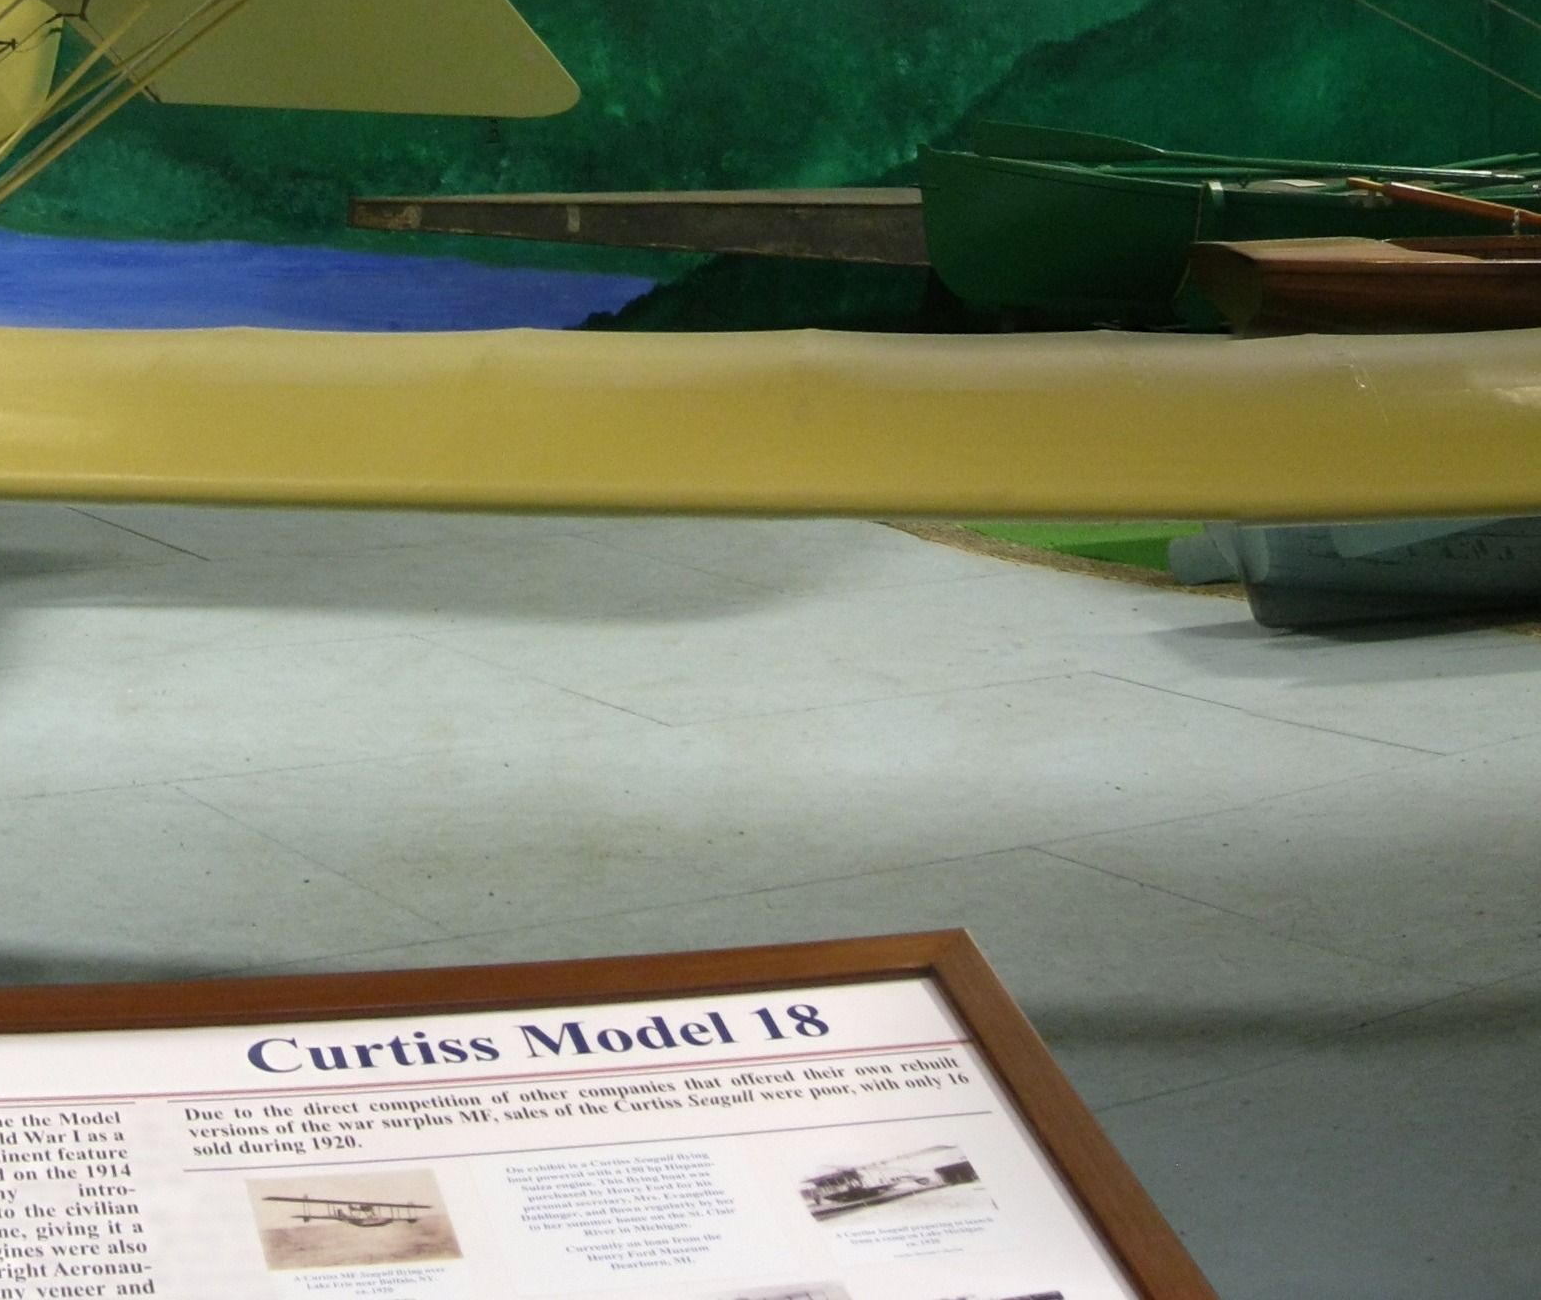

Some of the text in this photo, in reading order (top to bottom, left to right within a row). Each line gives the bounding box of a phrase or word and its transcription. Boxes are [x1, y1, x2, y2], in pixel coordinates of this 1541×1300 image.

[247, 1003, 830, 1074] Curtiss Model 18
[185, 1057, 957, 1121] Due to the direct competition of other companies that offered their own rebuilt
[188, 1073, 969, 1138] versions of the war surplus MF, sales of the Curtiss Seagull were poor, with only 16
[20, 1114, 53, 1126] the
[59, 1111, 121, 1125] Model
[22, 1131, 67, 1144] War
[72, 1130, 81, 1142] I
[86, 1133, 108, 1142] as
[112, 1132, 125, 1141] a
[192, 1135, 364, 1156] sold during 1920.
[57, 1148, 128, 1161] feature
[12, 1171, 38, 1180] on
[45, 1166, 78, 1179] the
[86, 1164, 132, 1178] 1914
[78, 1184, 136, 1197] intro-
[23, 1204, 57, 1218] the
[64, 1201, 140, 1216] civilian
[35, 1221, 99, 1241] giving
[107, 1220, 122, 1234] it
[131, 1223, 144, 1233] a
[49, 1244, 101, 1256] were
[107, 1239, 148, 1254] also
[53, 1262, 152, 1276] Aeronau-
[36, 1285, 107, 1298] veneer
[115, 1279, 156, 1295] and
